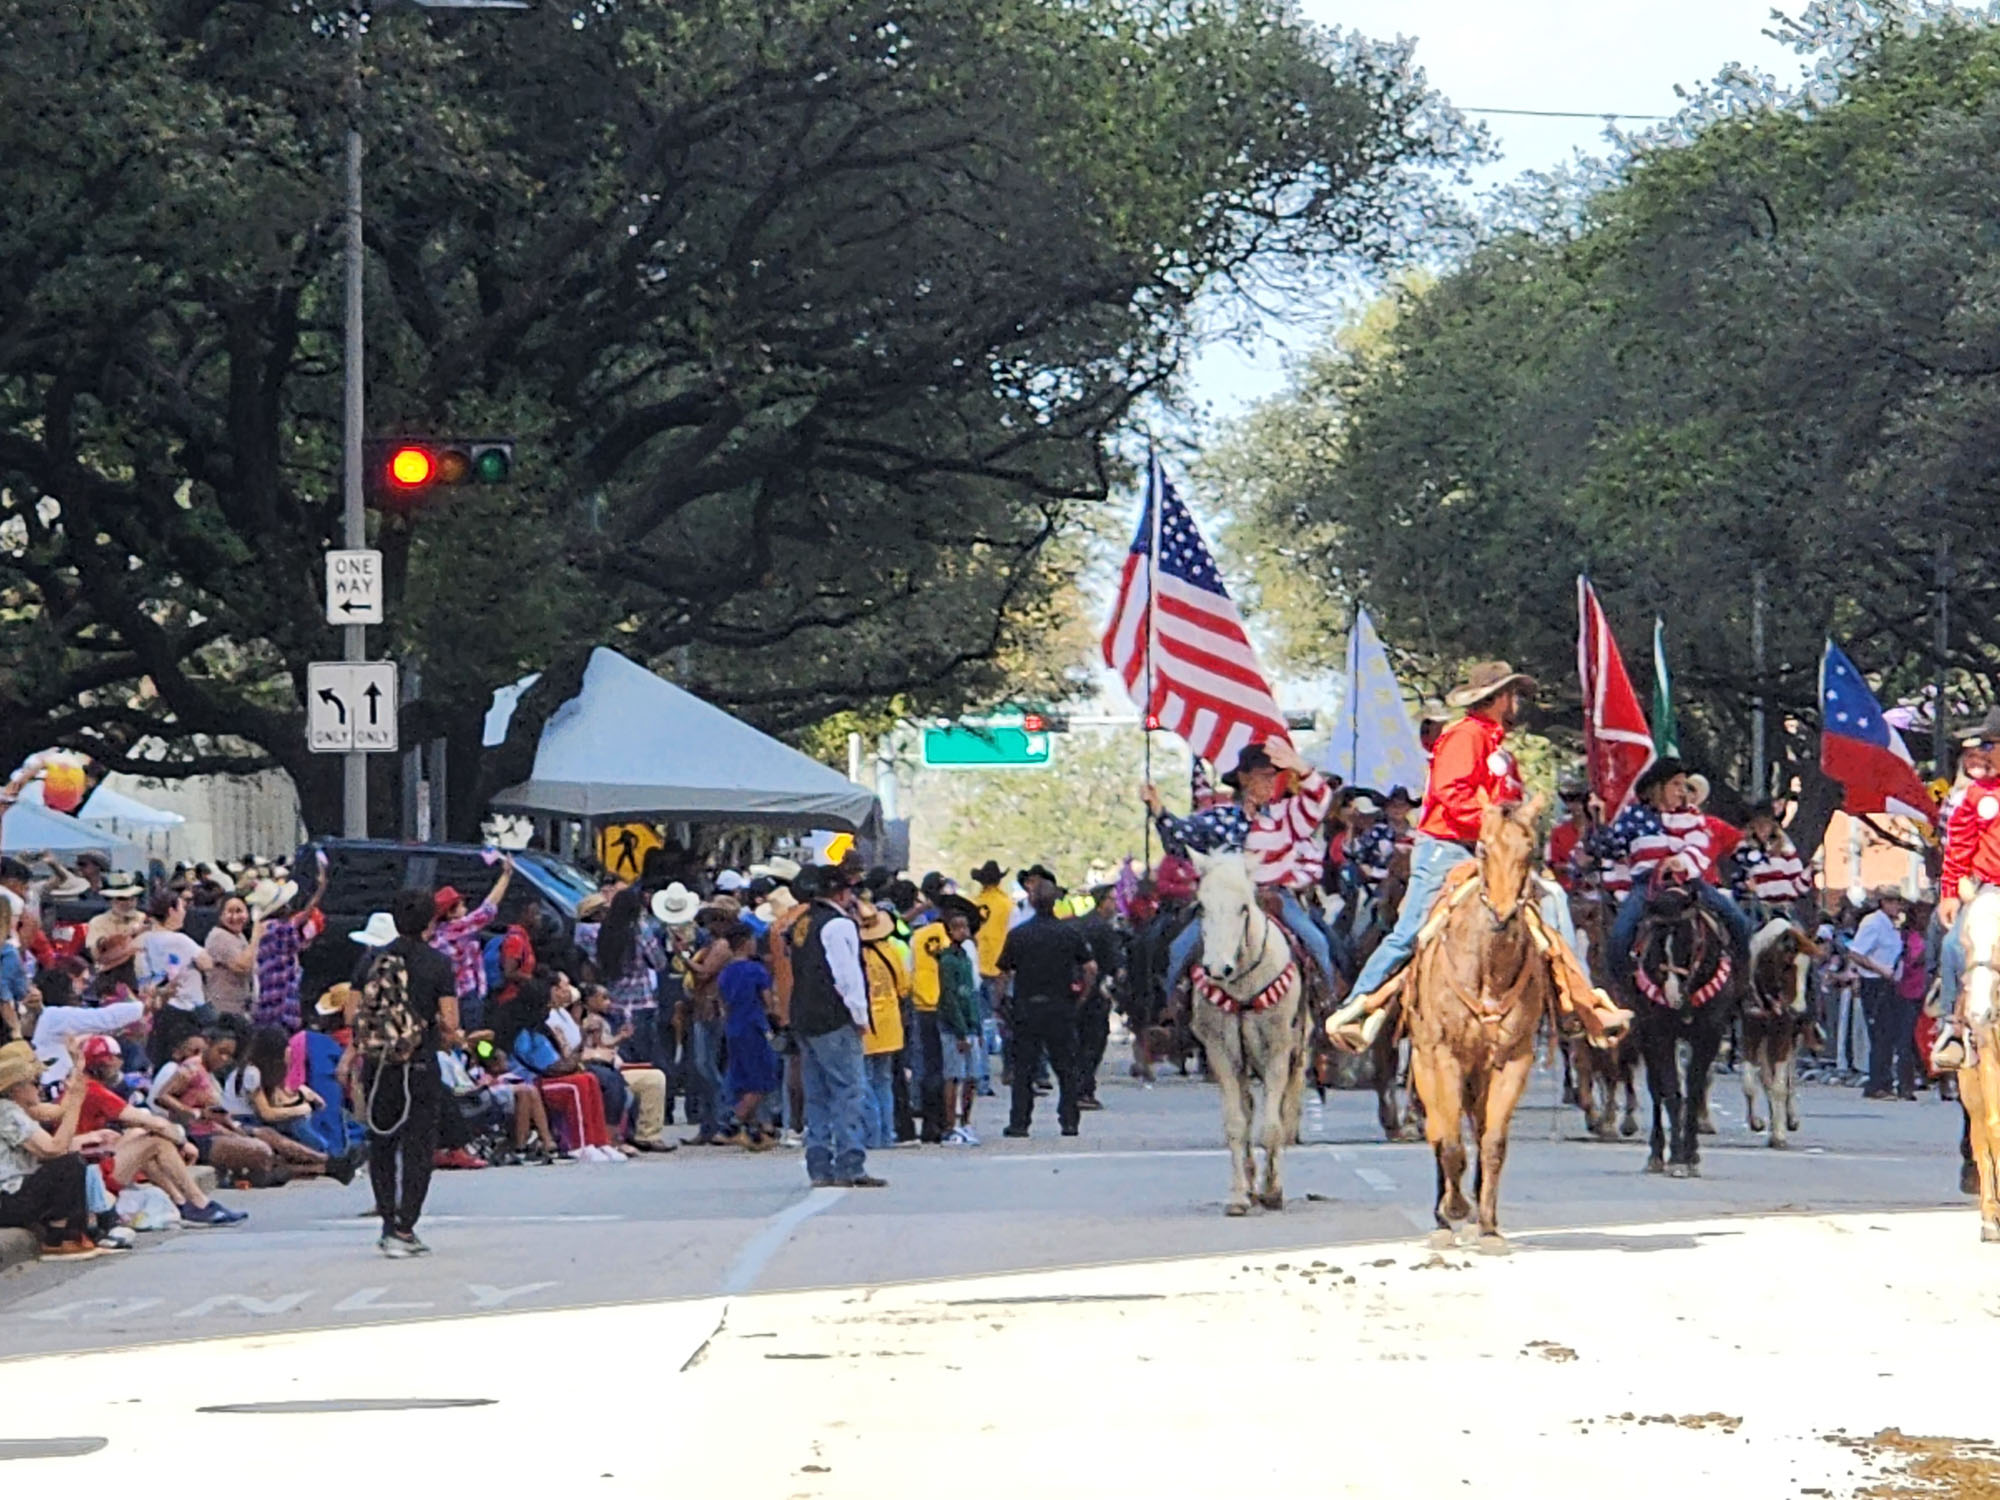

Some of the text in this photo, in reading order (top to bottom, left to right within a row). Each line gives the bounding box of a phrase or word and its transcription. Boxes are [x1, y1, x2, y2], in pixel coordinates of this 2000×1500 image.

[335, 558, 373, 575] ONE
[334, 578, 373, 594] WAY
[315, 729, 347, 743] ONLY
[357, 729, 388, 743] ONLY
